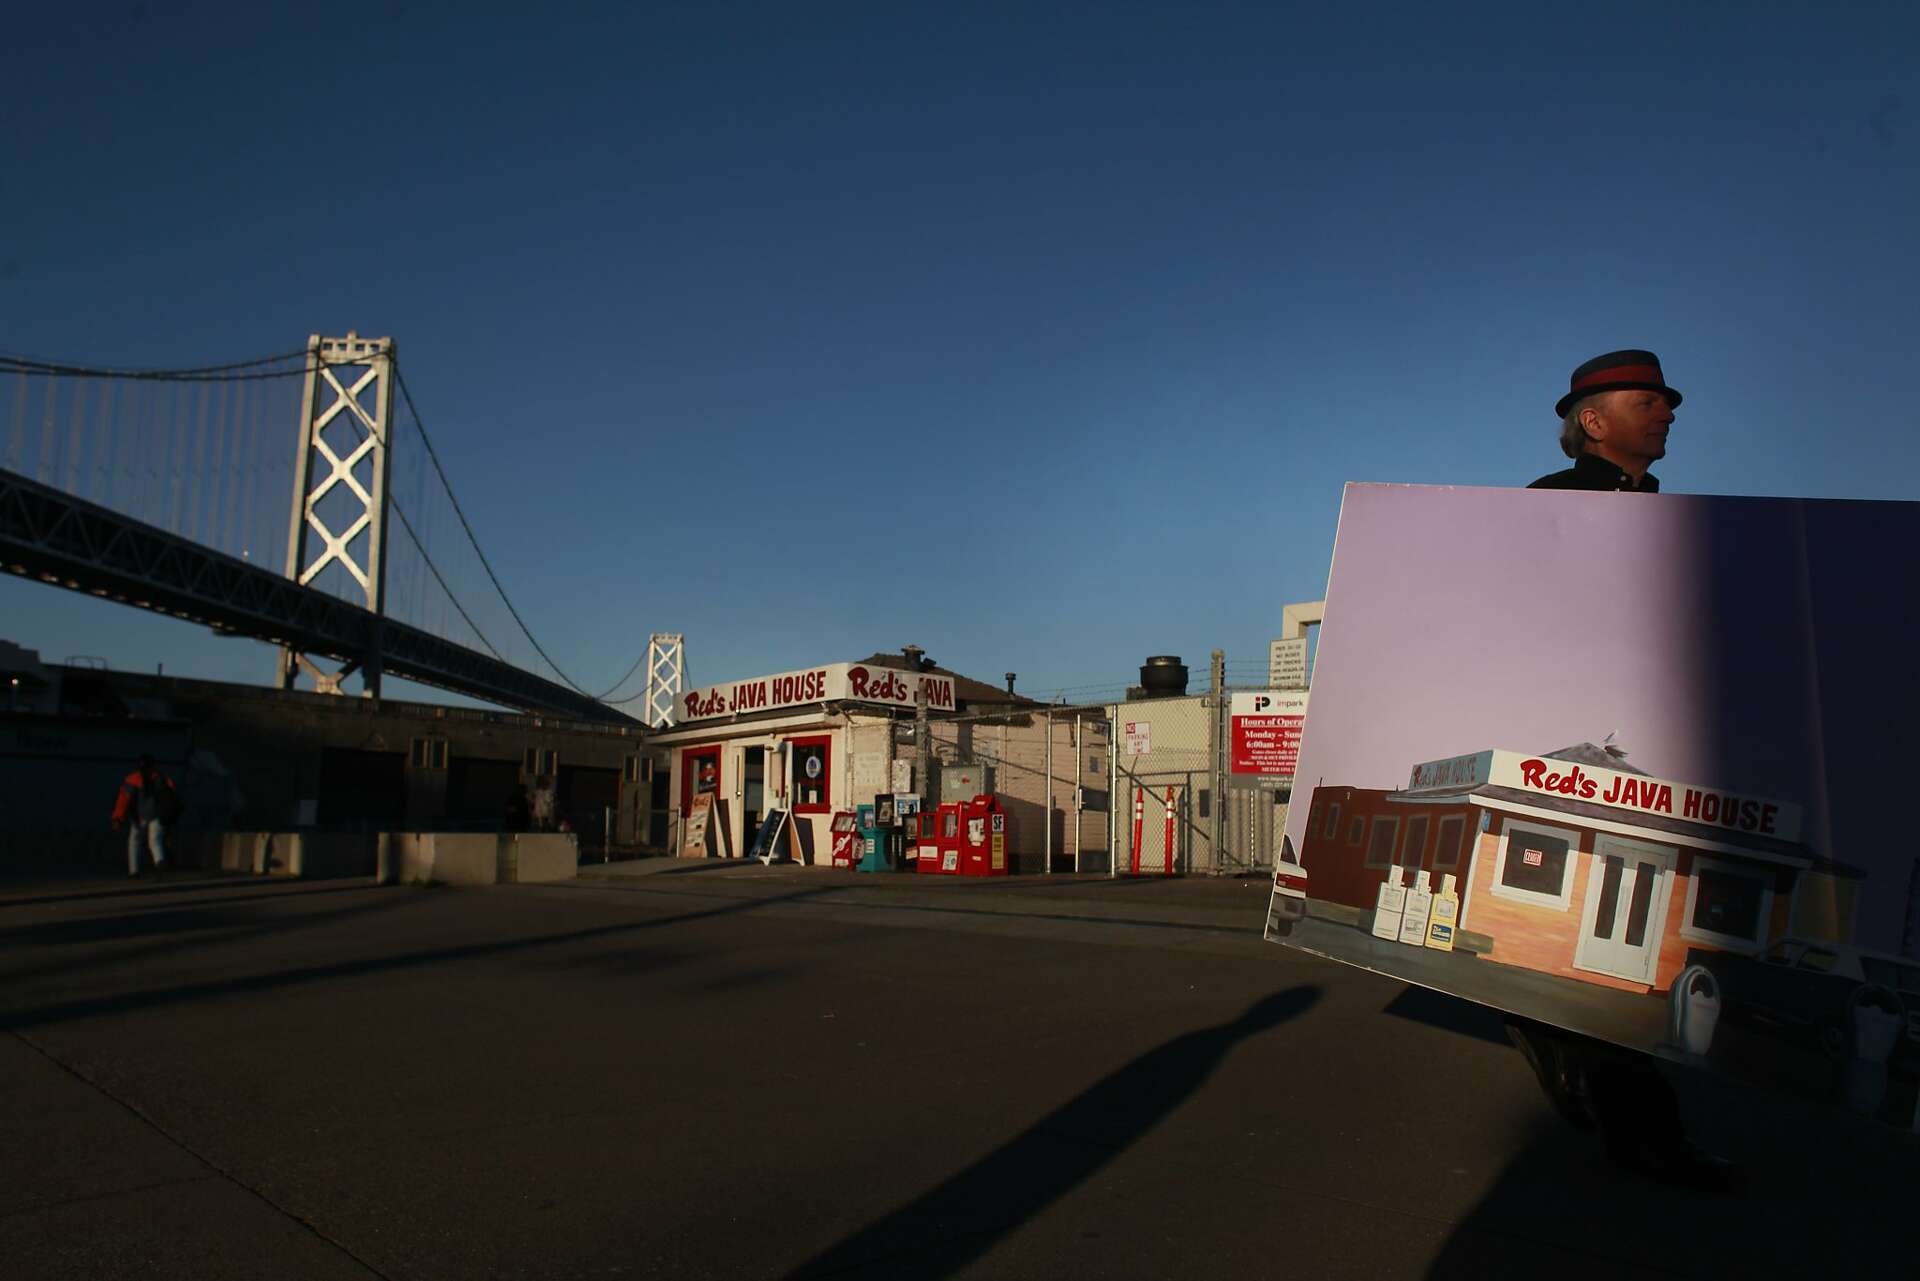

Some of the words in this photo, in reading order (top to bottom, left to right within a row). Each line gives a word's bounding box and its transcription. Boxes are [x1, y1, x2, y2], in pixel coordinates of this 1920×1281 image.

[847, 667, 907, 702] Red's
[684, 688, 725, 717] Red's
[729, 682, 767, 711] JAVA
[772, 670, 827, 705] HOUSE
[1241, 717, 1265, 727] Hours
[1267, 717, 1276, 726] of
[1245, 730, 1276, 739] Monday
[1246, 741, 1275, 749] 6:00am
[1520, 759, 1598, 799] Red's
[1603, 776, 1673, 814] JAVA
[1683, 789, 1779, 834] HOUSE
[993, 815, 1003, 830] SF
